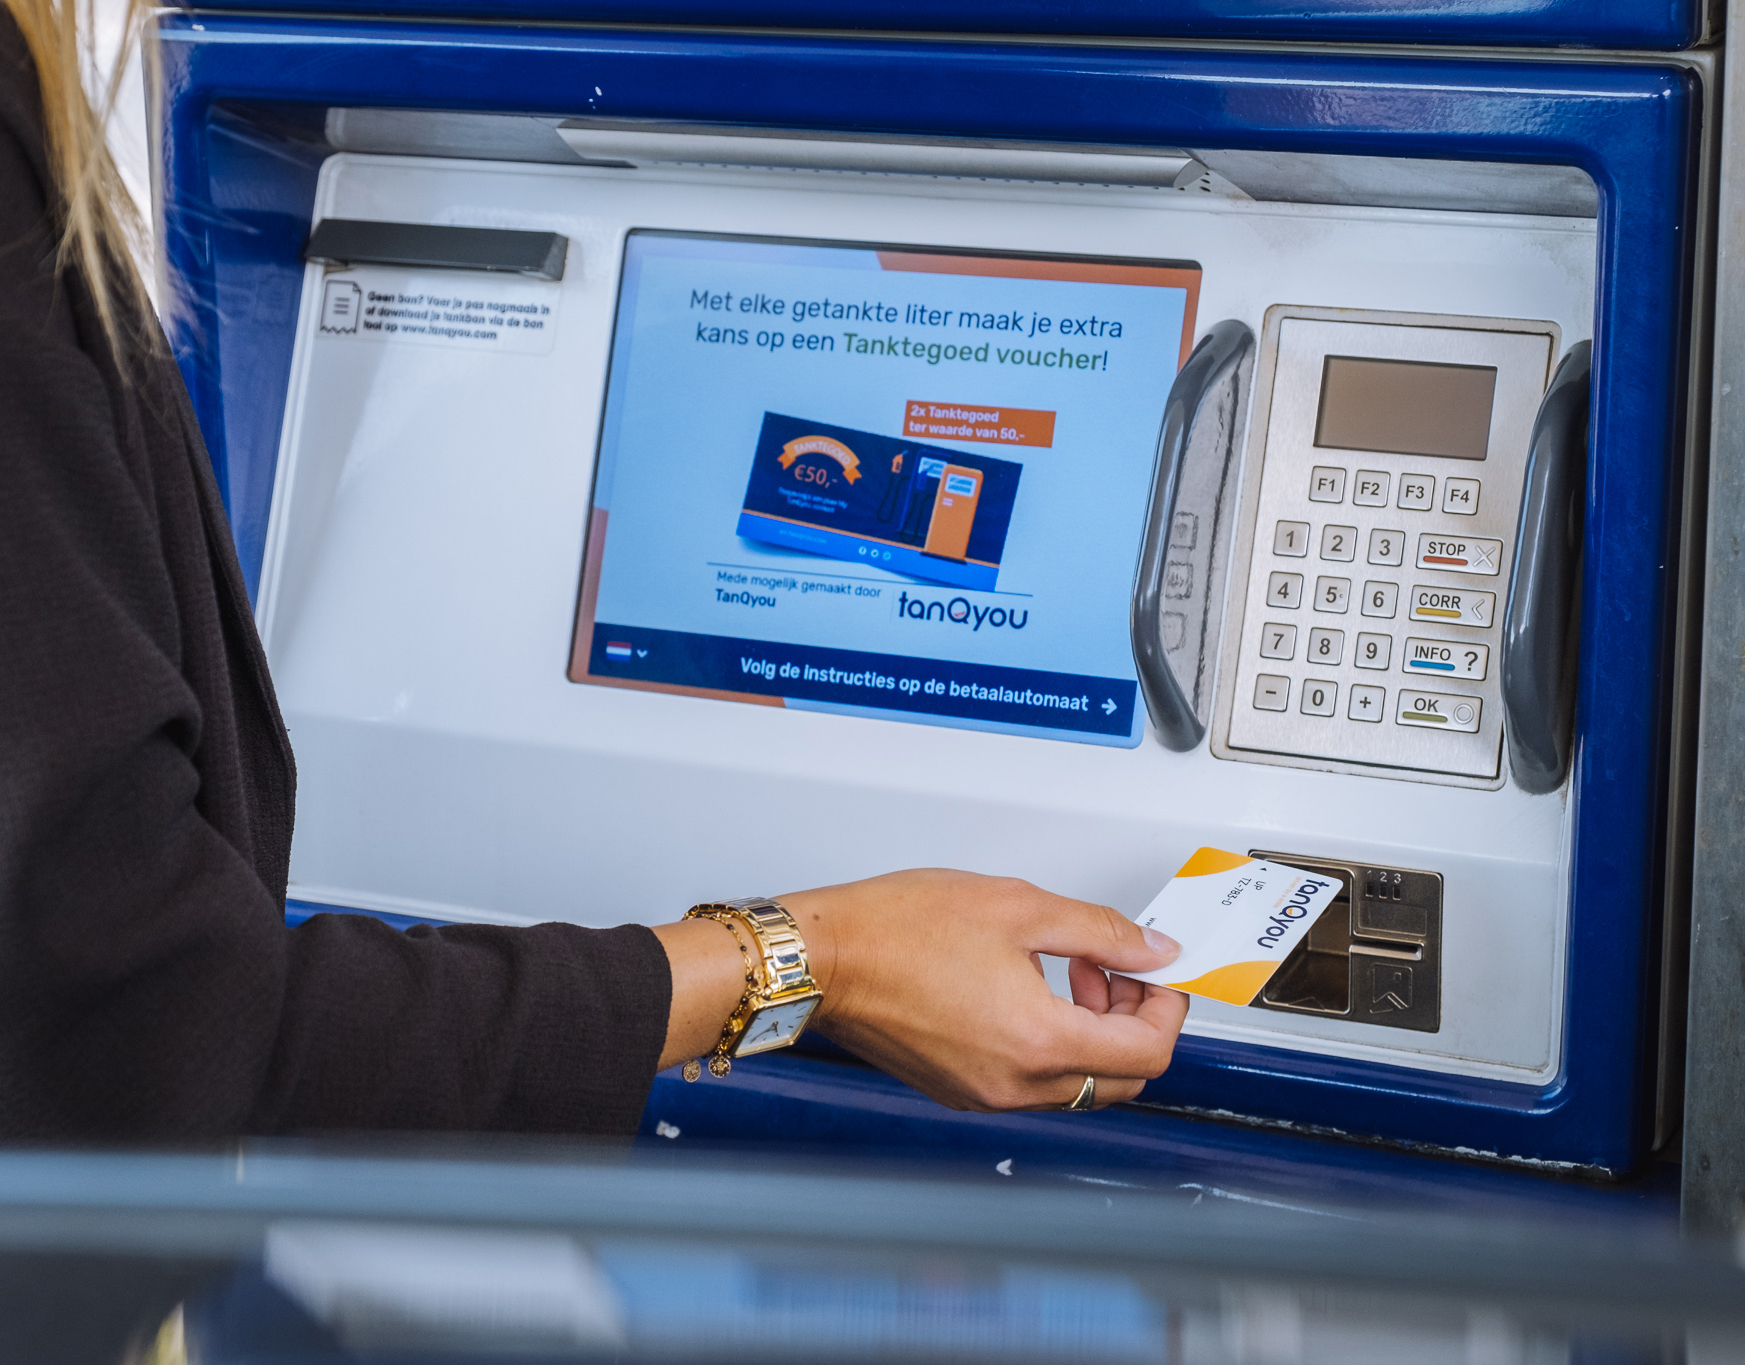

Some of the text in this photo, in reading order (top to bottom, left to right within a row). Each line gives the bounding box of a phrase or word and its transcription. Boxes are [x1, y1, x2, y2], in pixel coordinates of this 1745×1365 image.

[378, 306, 428, 321] download
[488, 314, 504, 326] via
[506, 315, 520, 328] de
[523, 317, 543, 329] bon
[540, 303, 550, 316] in
[689, 289, 1123, 339] Met elke getankte liter maak je extra
[695, 321, 1108, 371] kans op een Tanktegoed voucher!
[910, 404, 999, 424] 2x Tanktegoed
[909, 420, 927, 433] ter
[928, 424, 973, 436] waarde
[975, 427, 998, 439] van
[794, 463, 838, 489] €50,-
[1317, 478, 1336, 493] F1
[1360, 481, 1380, 496] F2
[1405, 485, 1425, 500] F3
[1449, 488, 1470, 503] F4
[1285, 530, 1295, 548] 1
[1331, 534, 1344, 552] 2
[1378, 538, 1391, 557] 3
[1427, 541, 1466, 556] STOP
[717, 571, 882, 598] Mede mogelijk gemaakt door
[1277, 582, 1289, 599] 4
[715, 589, 777, 608] TanQyou
[1325, 586, 1338, 603] 5
[1372, 590, 1385, 608] 6
[1418, 592, 1461, 610] CORR
[898, 591, 1028, 631] tanQyou
[1273, 632, 1285, 650] 7
[1318, 637, 1331, 655] 8
[1366, 642, 1378, 660] 9
[1414, 645, 1451, 661] INFO
[741, 657, 1090, 712] Volg de instructies op de betaalautomaat
[1312, 689, 1324, 707] 0
[1413, 697, 1440, 713] OK
[1254, 880, 1267, 891] UP
[1380, 871, 1388, 883] 2
[1394, 873, 1402, 884] 3
[1257, 879, 1330, 949] tanQyou
